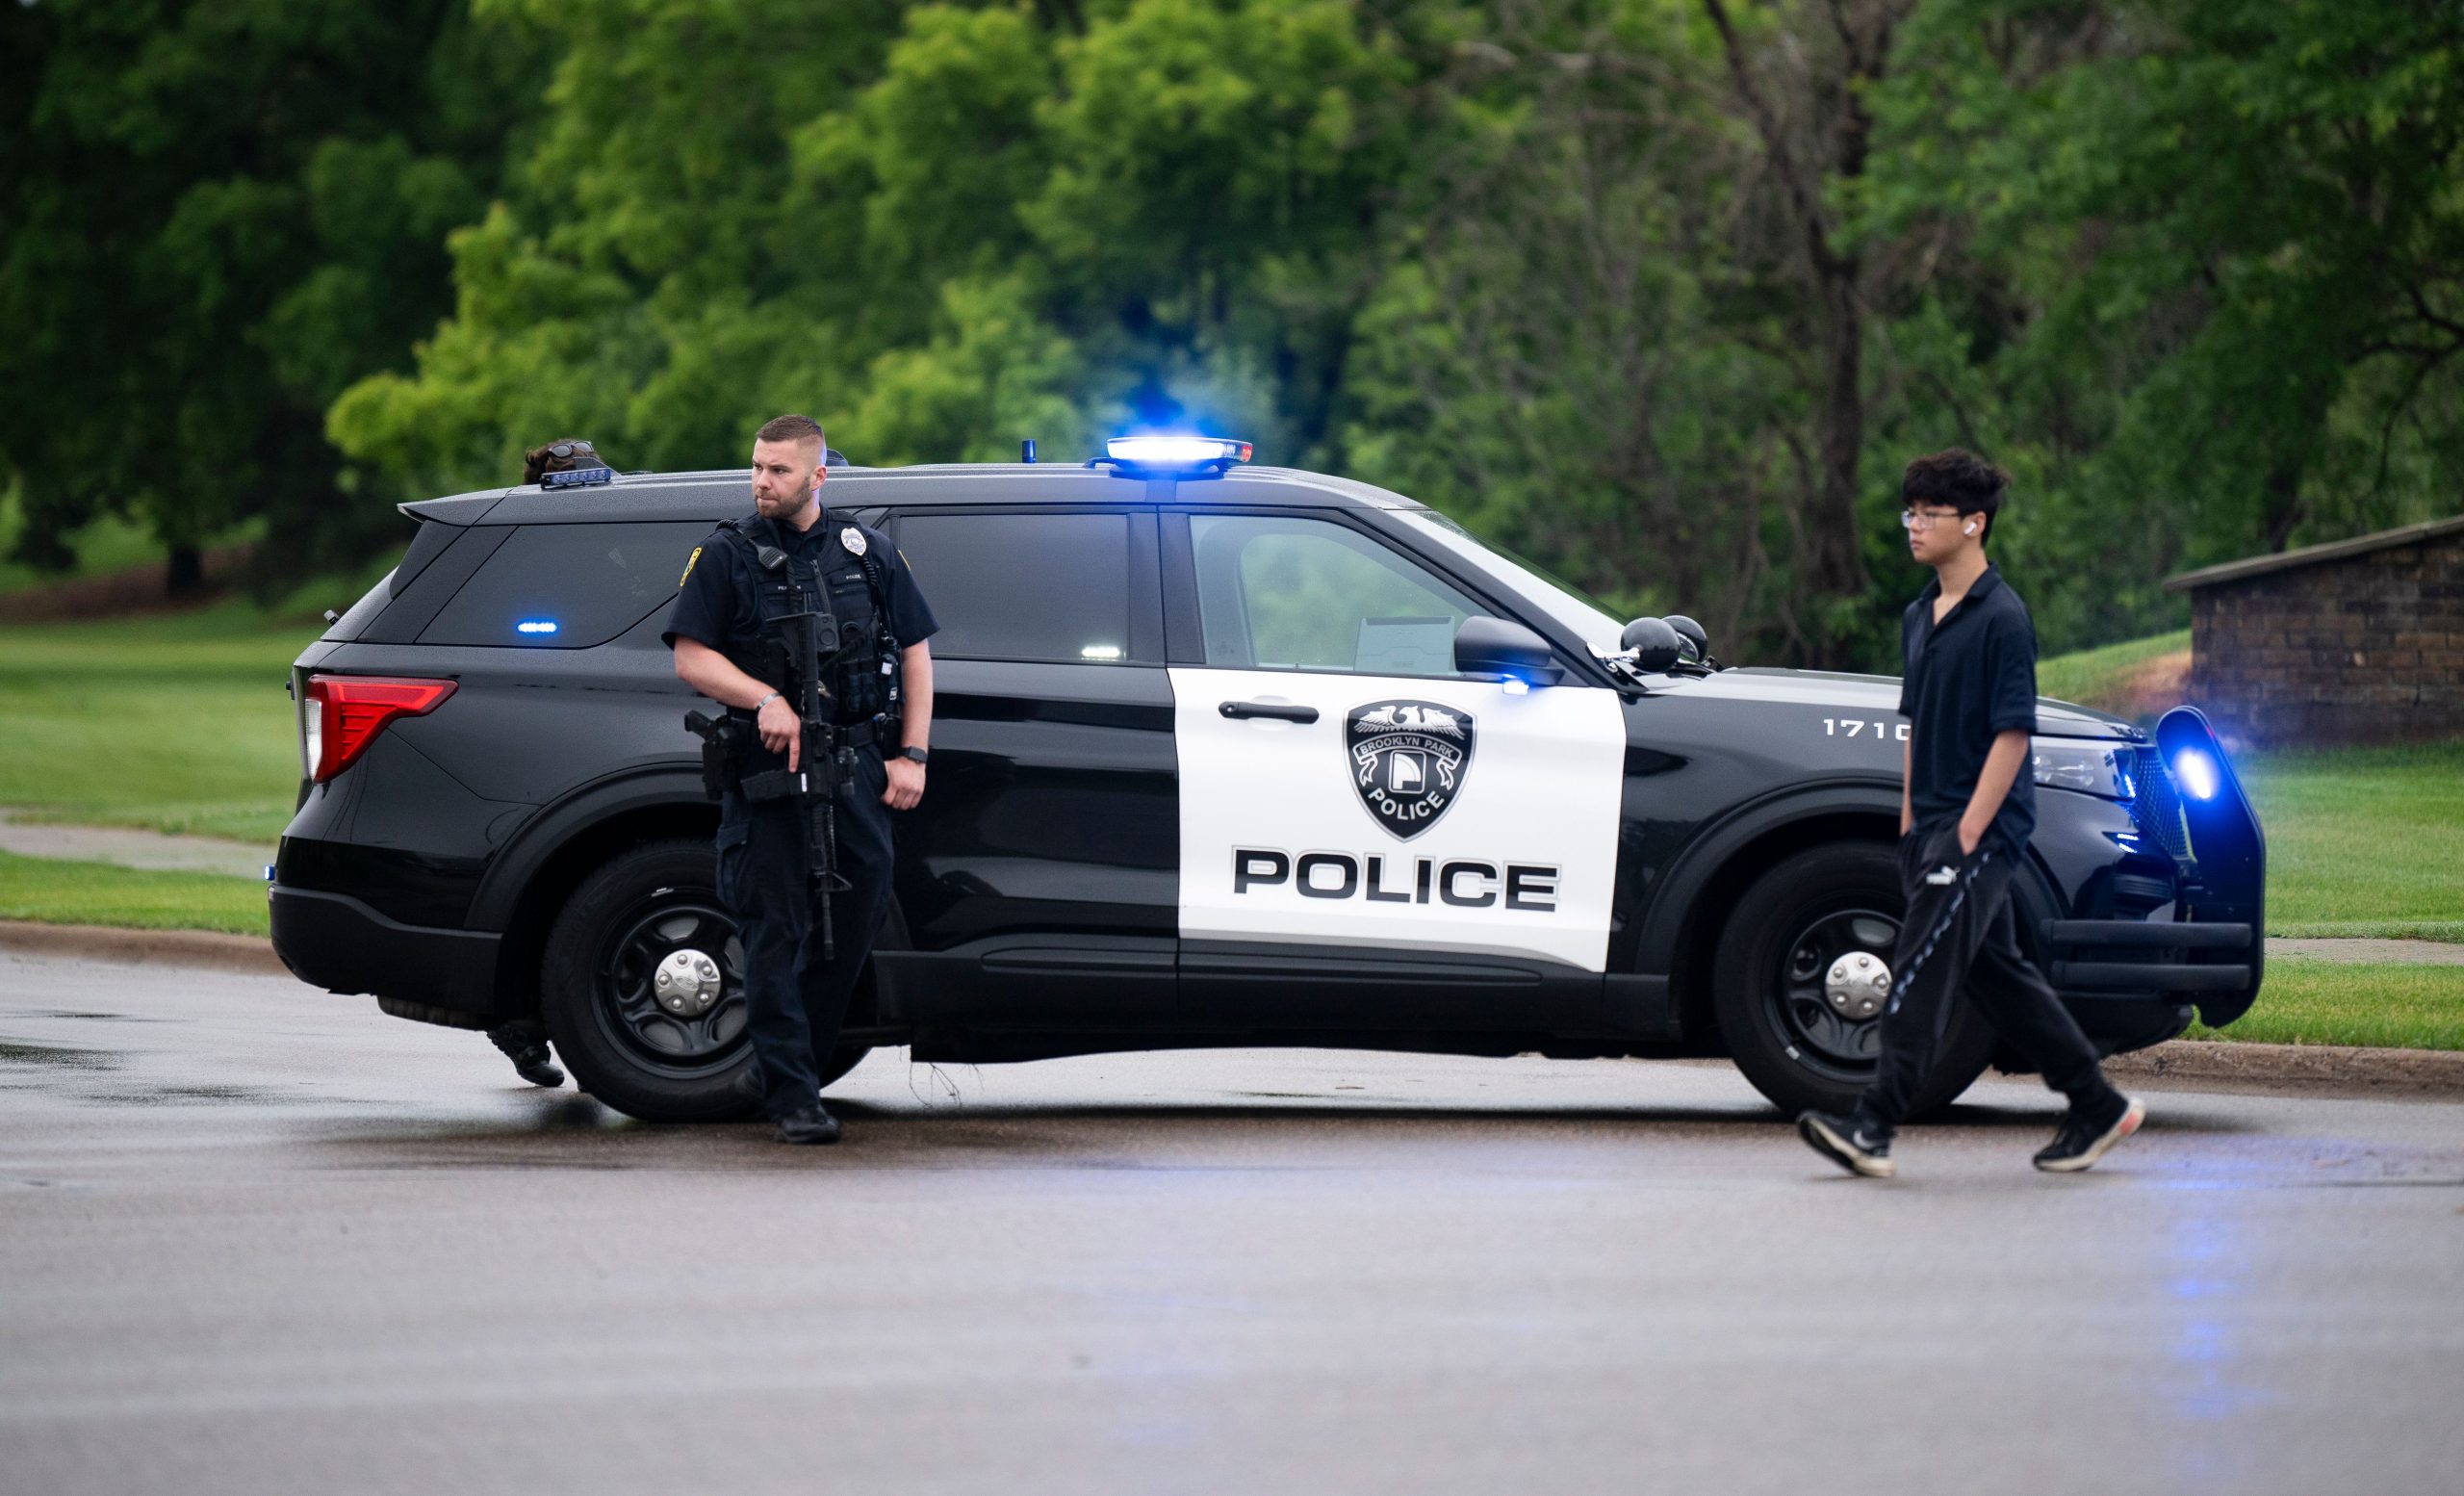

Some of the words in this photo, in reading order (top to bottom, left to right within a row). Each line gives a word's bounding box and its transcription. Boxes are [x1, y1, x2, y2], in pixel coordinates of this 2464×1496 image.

[1360, 736, 1420, 755] BROOKLYN
[1424, 740, 1454, 758] PARK
[1368, 787, 1445, 820] POLICE
[1233, 847, 1559, 913] POLICE
